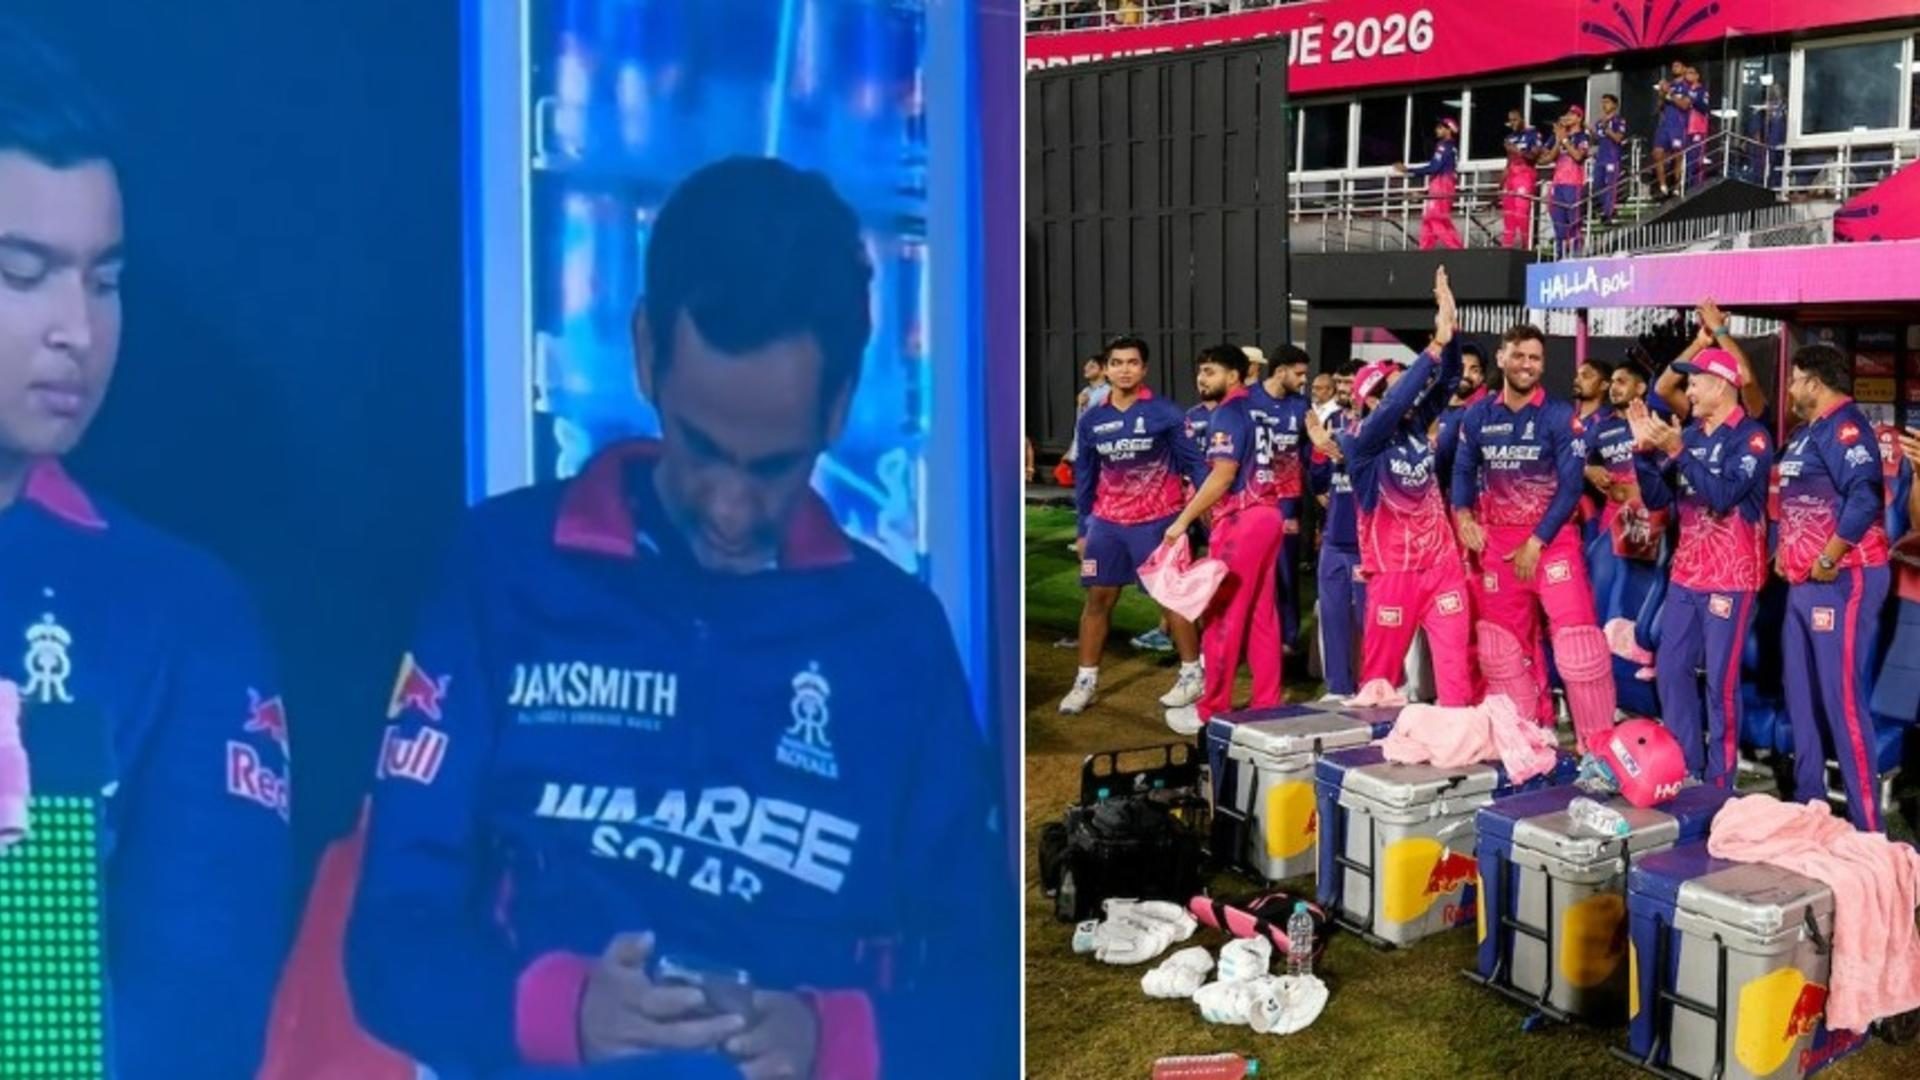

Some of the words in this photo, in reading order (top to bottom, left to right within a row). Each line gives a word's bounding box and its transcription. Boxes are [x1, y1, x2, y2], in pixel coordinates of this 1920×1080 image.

[1331, 9, 1434, 63] 2026
[1540, 265, 1599, 303] HALLA
[508, 660, 678, 717] JAKSMITH
[378, 725, 449, 785] ull
